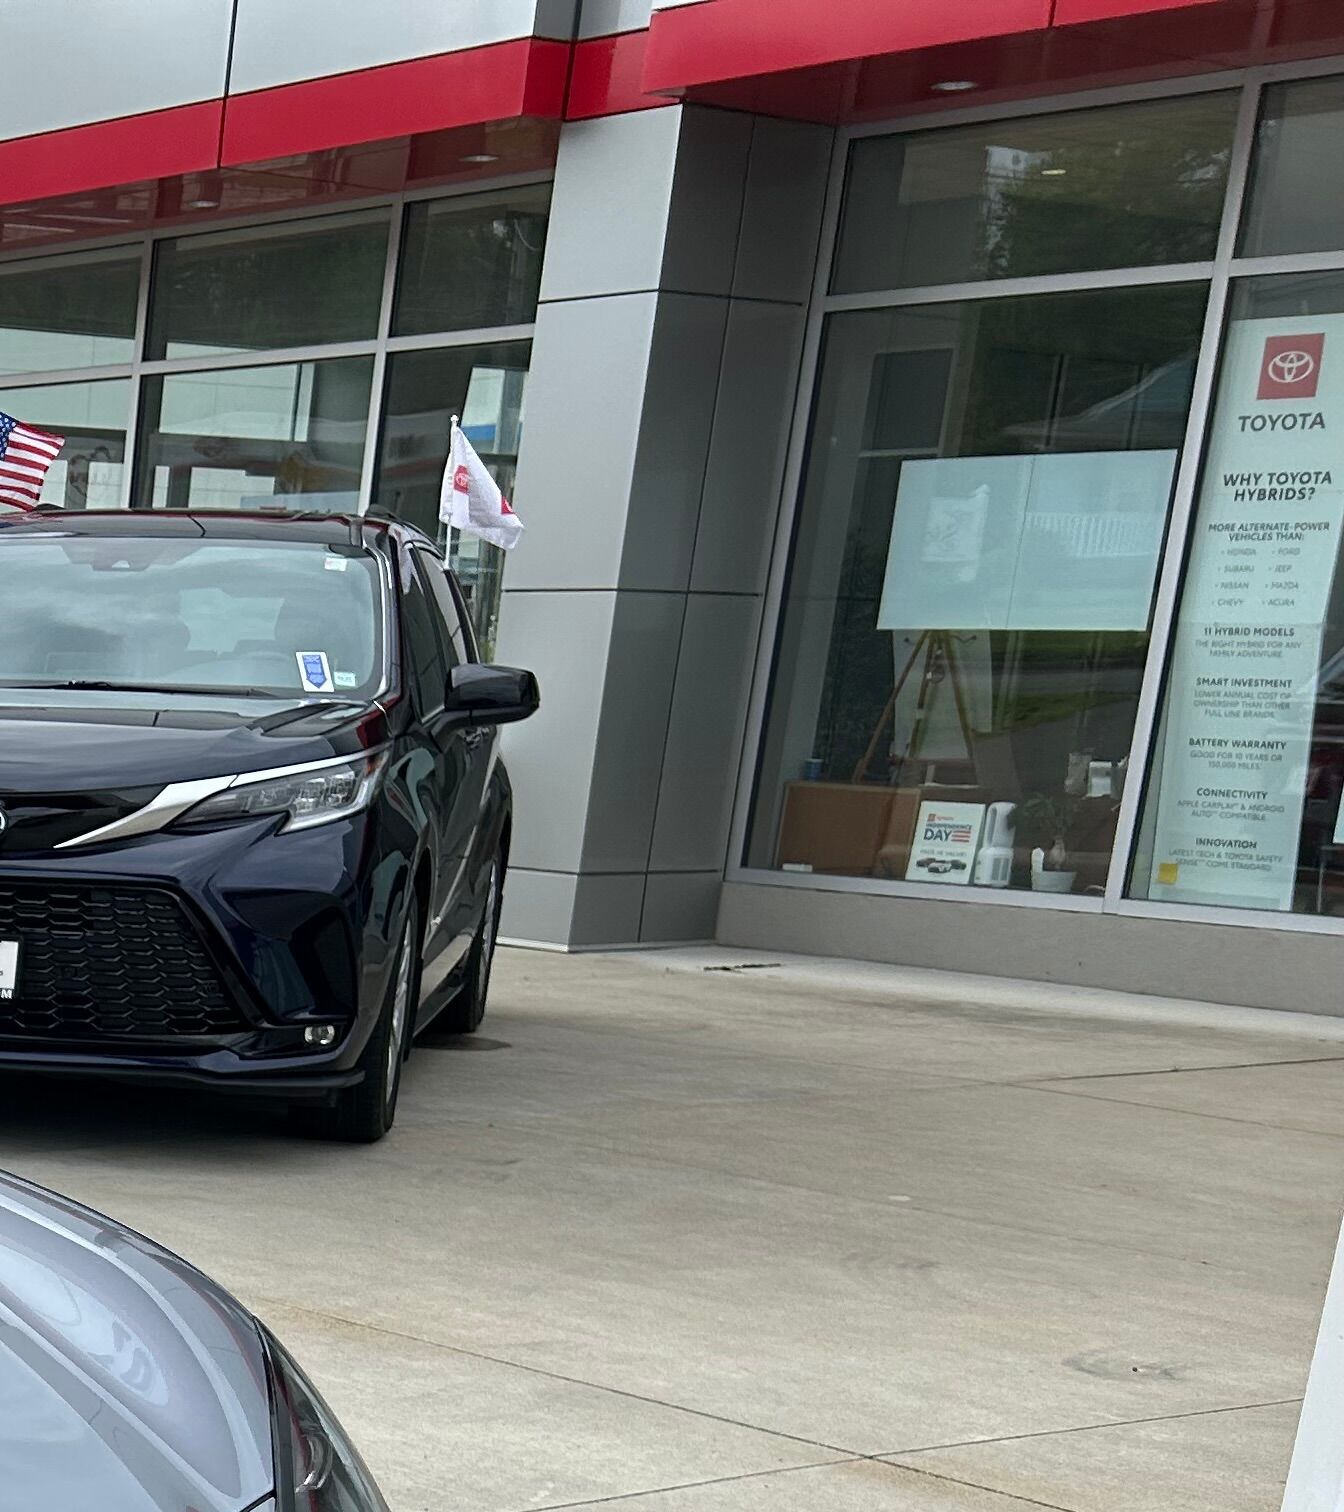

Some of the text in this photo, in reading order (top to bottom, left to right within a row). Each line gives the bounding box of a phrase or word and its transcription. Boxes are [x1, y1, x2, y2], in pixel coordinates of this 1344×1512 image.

[1238, 412, 1325, 432] TOYOTA
[1223, 471, 1332, 487] WHY TOYOTA
[1234, 487, 1316, 502] HYBRIDS?
[1208, 521, 1330, 532] MORE ALTERNATE-POWER
[1229, 532, 1305, 542] VEHICLES THAN:
[1224, 565, 1254, 573] SUBARU
[1275, 564, 1292, 573] JEEP
[1220, 582, 1249, 590] NISSAN
[1271, 581, 1299, 590] MAZDA
[1217, 599, 1243, 607] CHEVY
[1268, 599, 1295, 607] ACURA
[1204, 627, 1295, 637] 11 HYBRID MODELS
[1196, 678, 1293, 689] SMART INVESTMENT
[1242, 701, 1262, 709] THAN
[1265, 702, 1290, 710] OTHER
[1189, 737, 1287, 750] BATTERY WARRANTY
[1190, 750, 1215, 759] GOOD
[1217, 751, 1233, 759] FOR
[1245, 753, 1269, 762] YEARS
[1271, 754, 1282, 762] OR
[1196, 787, 1268, 800] CONNECTIVITY
[1177, 800, 1199, 809] APPLE
[924, 828, 952, 841] DAY
[1195, 837, 1257, 849] INNOVATION
